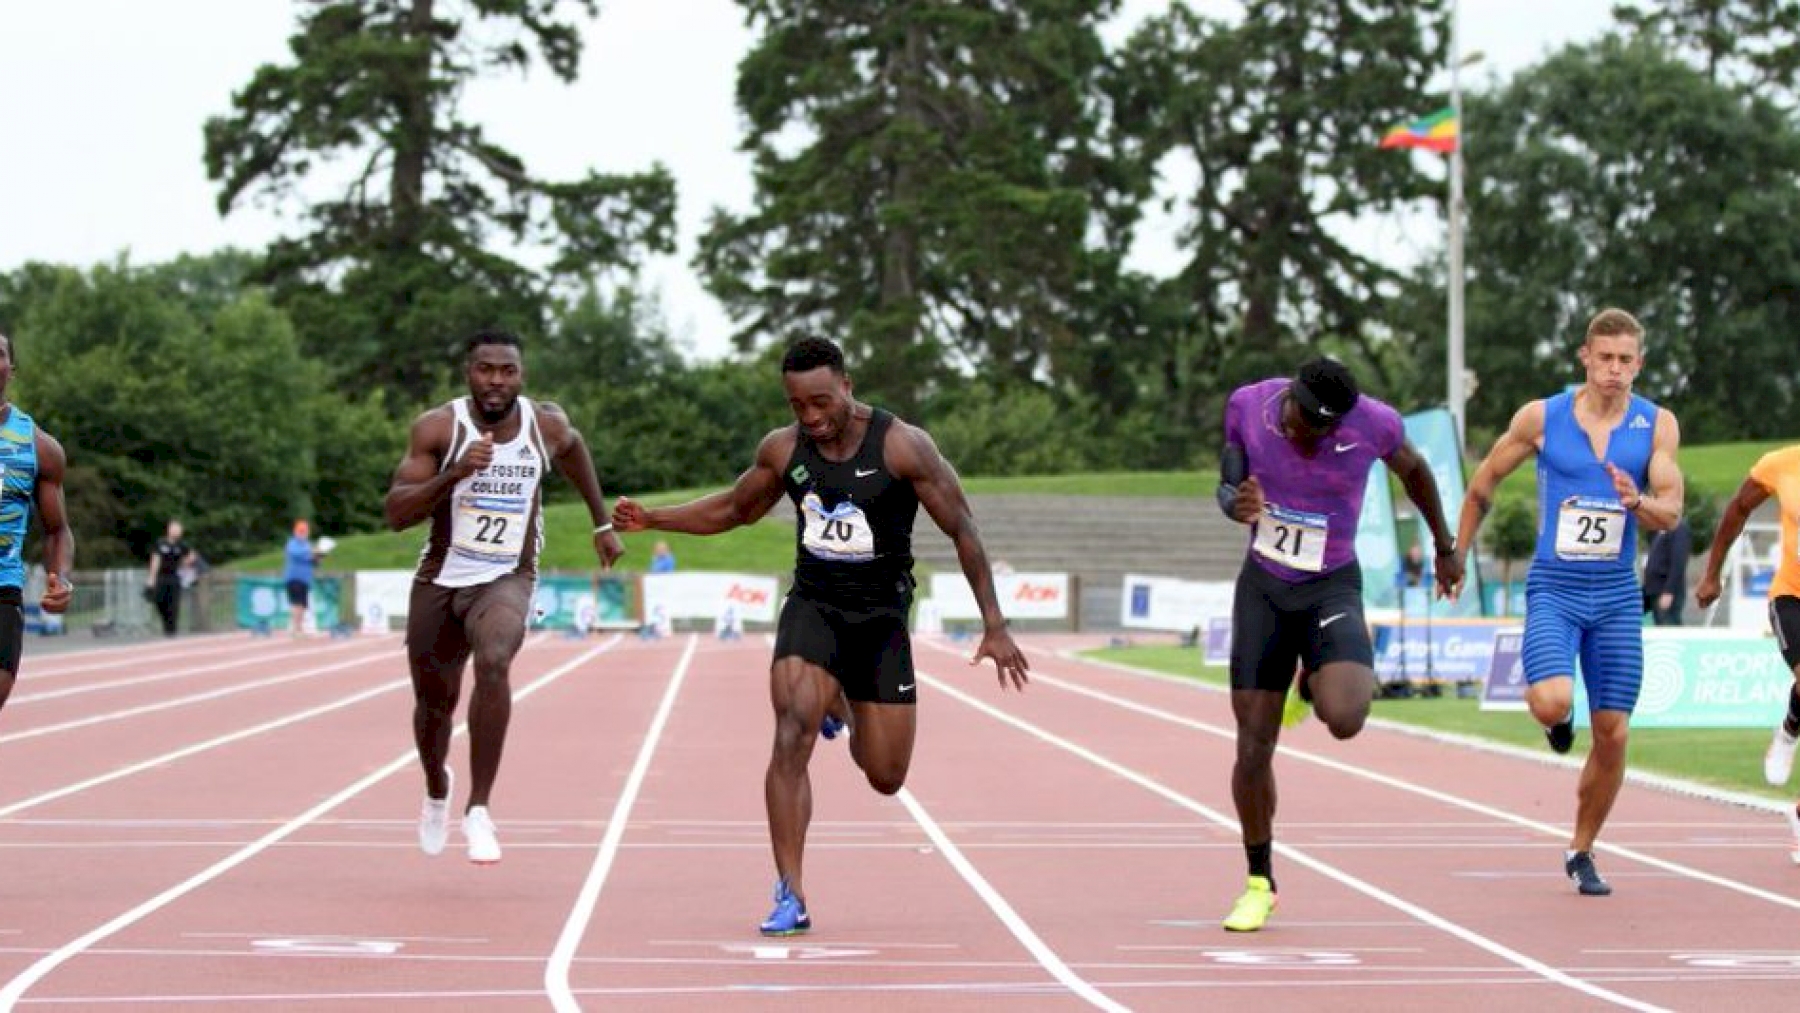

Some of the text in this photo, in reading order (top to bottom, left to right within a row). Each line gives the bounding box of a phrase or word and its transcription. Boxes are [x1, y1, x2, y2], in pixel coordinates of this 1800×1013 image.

[492, 465, 537, 479] FOSTER
[471, 480, 524, 495] COLLEGE
[473, 514, 508, 544] 22
[1273, 526, 1303, 556] 21
[1575, 515, 1608, 544] 25
[1693, 680, 1788, 703] IRELAN
